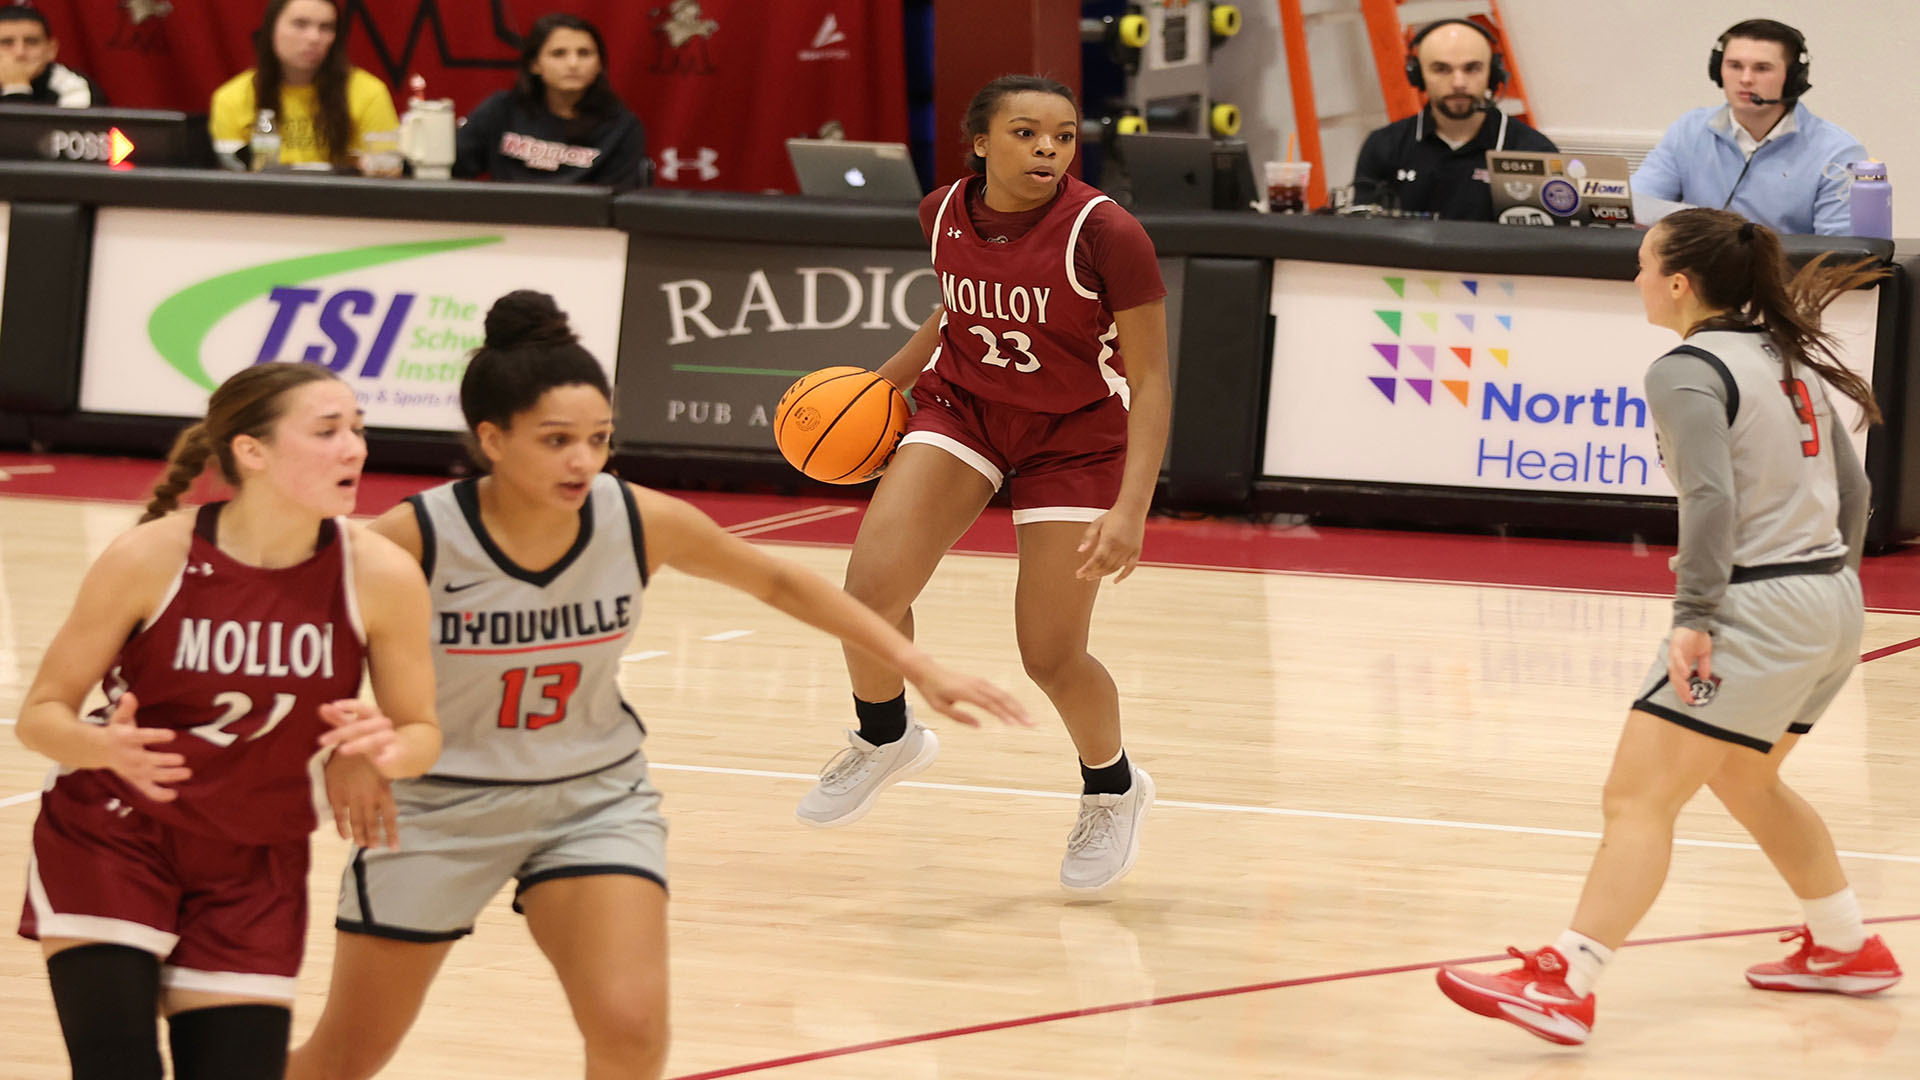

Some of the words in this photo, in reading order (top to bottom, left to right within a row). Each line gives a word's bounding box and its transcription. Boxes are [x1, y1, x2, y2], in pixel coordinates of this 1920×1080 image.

[429, 297, 477, 321] The
[942, 271, 1050, 323] MOLLOY
[254, 286, 415, 378] TSI
[968, 325, 1041, 373] 23
[668, 400, 732, 424] PUB
[1482, 382, 1646, 428] North
[1477, 438, 1648, 485] Health
[190, 690, 297, 748] 21
[498, 661, 582, 730] 13
